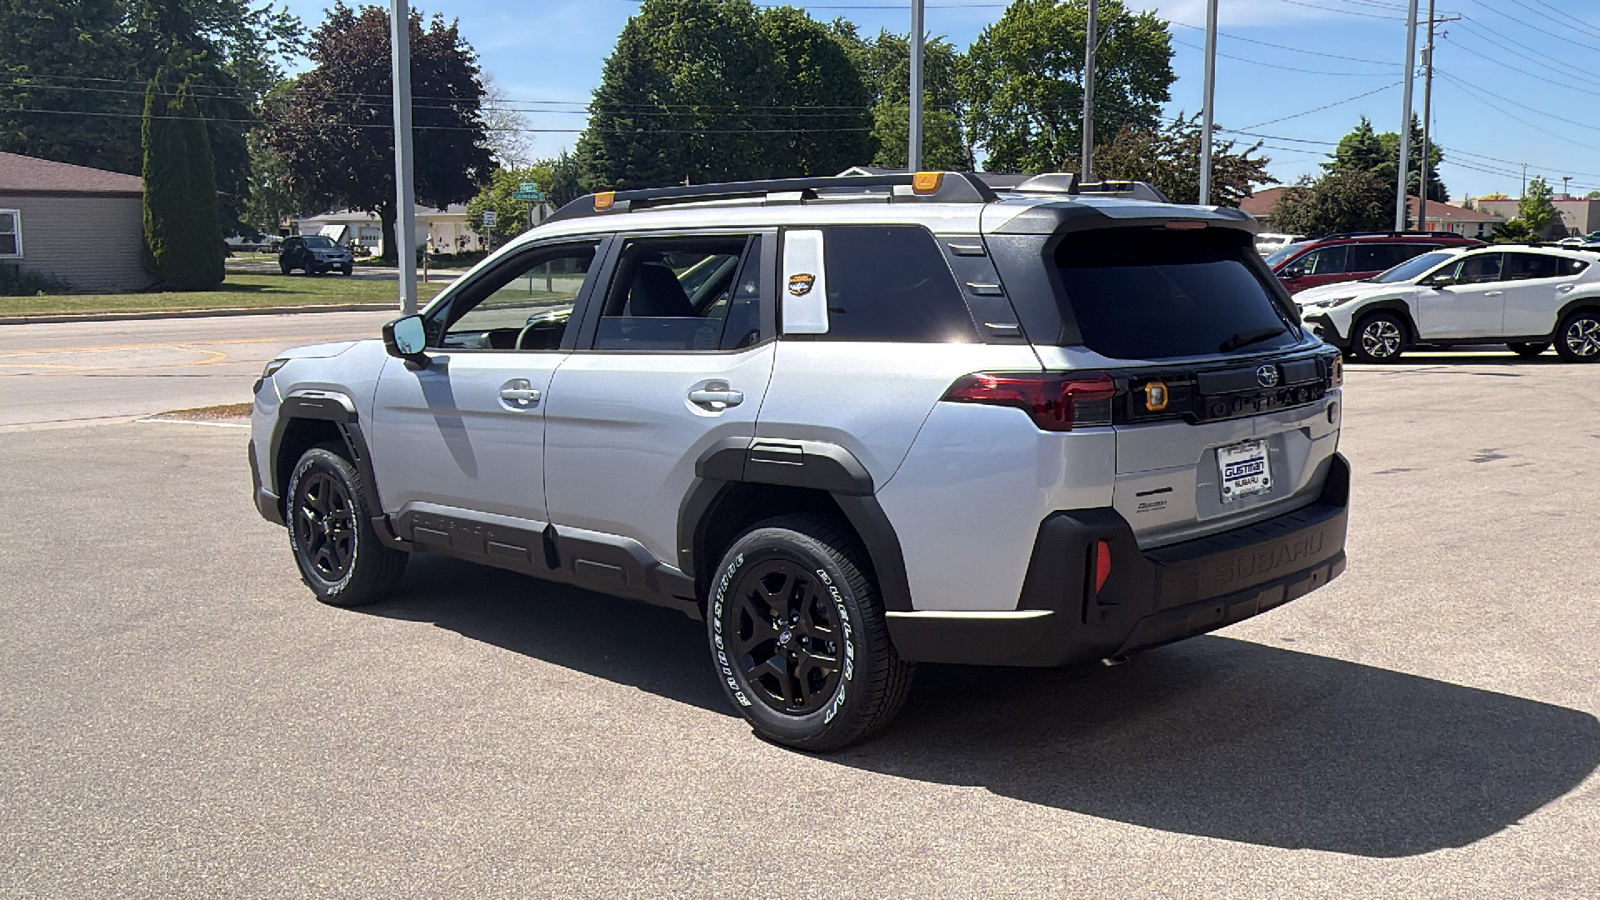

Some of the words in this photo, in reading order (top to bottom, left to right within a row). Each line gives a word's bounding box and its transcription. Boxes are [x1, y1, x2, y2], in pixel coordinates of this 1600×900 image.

[1235, 477, 1258, 487] SUBARU
[1214, 530, 1324, 584] SUBARU
[713, 552, 752, 707] BRIDGESTONE
[816, 568, 854, 681] DUELER
